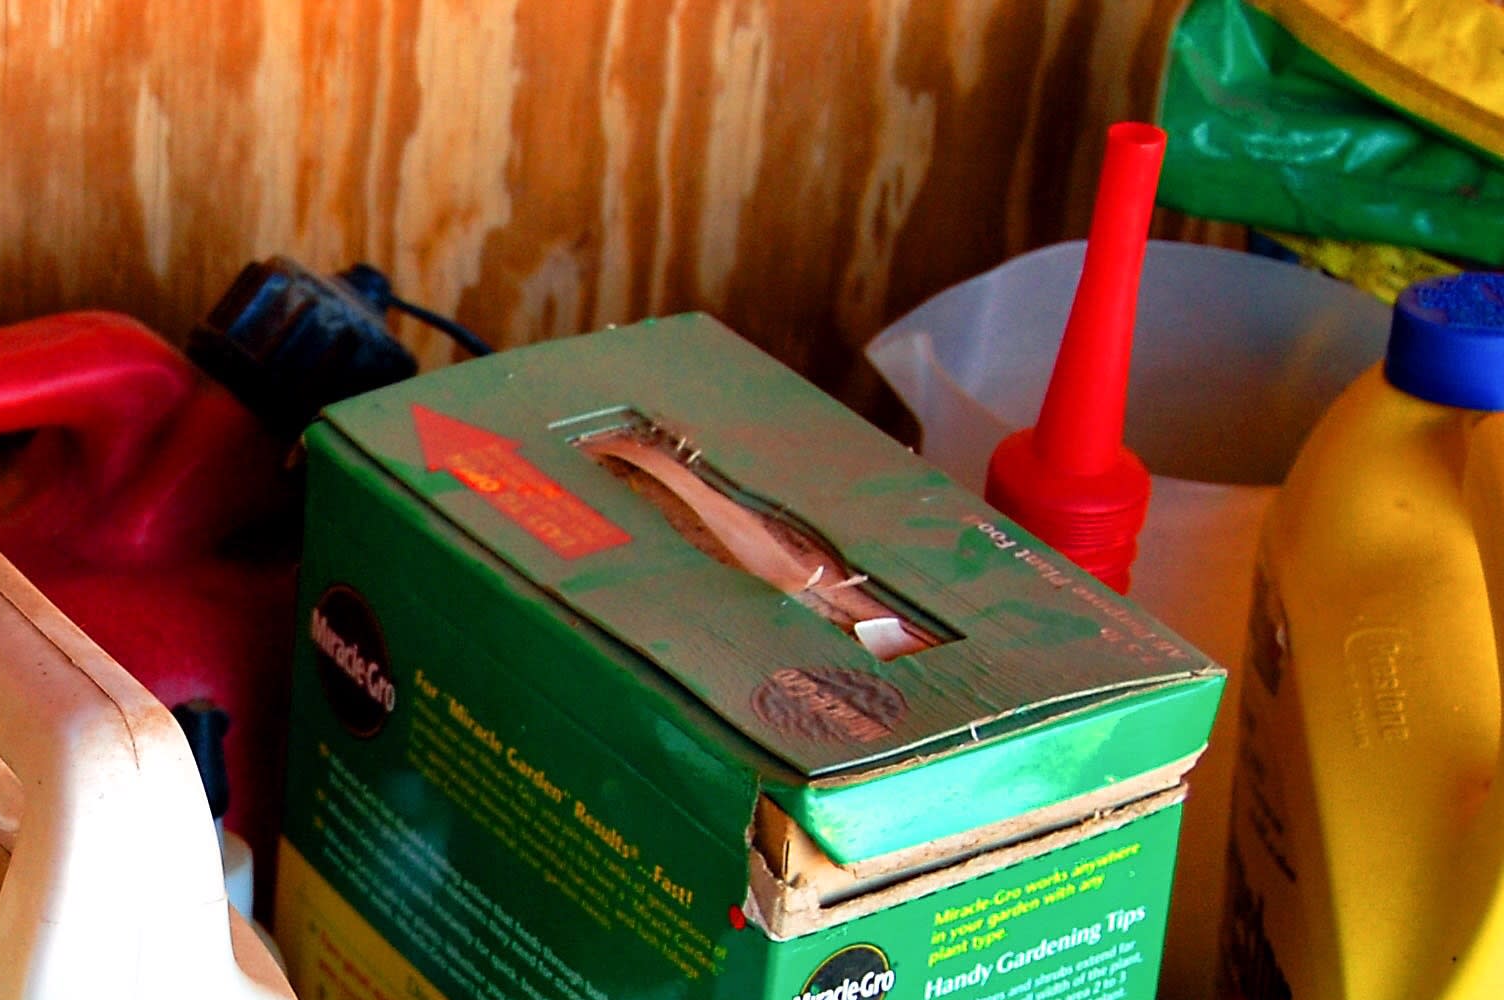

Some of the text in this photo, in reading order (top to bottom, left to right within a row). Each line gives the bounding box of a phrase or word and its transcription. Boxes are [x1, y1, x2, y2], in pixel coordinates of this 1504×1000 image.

[310, 606, 396, 713] Miracle-Gro
[415, 670, 437, 697] For
[931, 875, 1103, 943] in your garden with any
[934, 844, 1138, 924] Miracle-Gro works anywhere
[924, 907, 1144, 999] Handy Gardening Tips
[928, 940, 967, 965] plant
